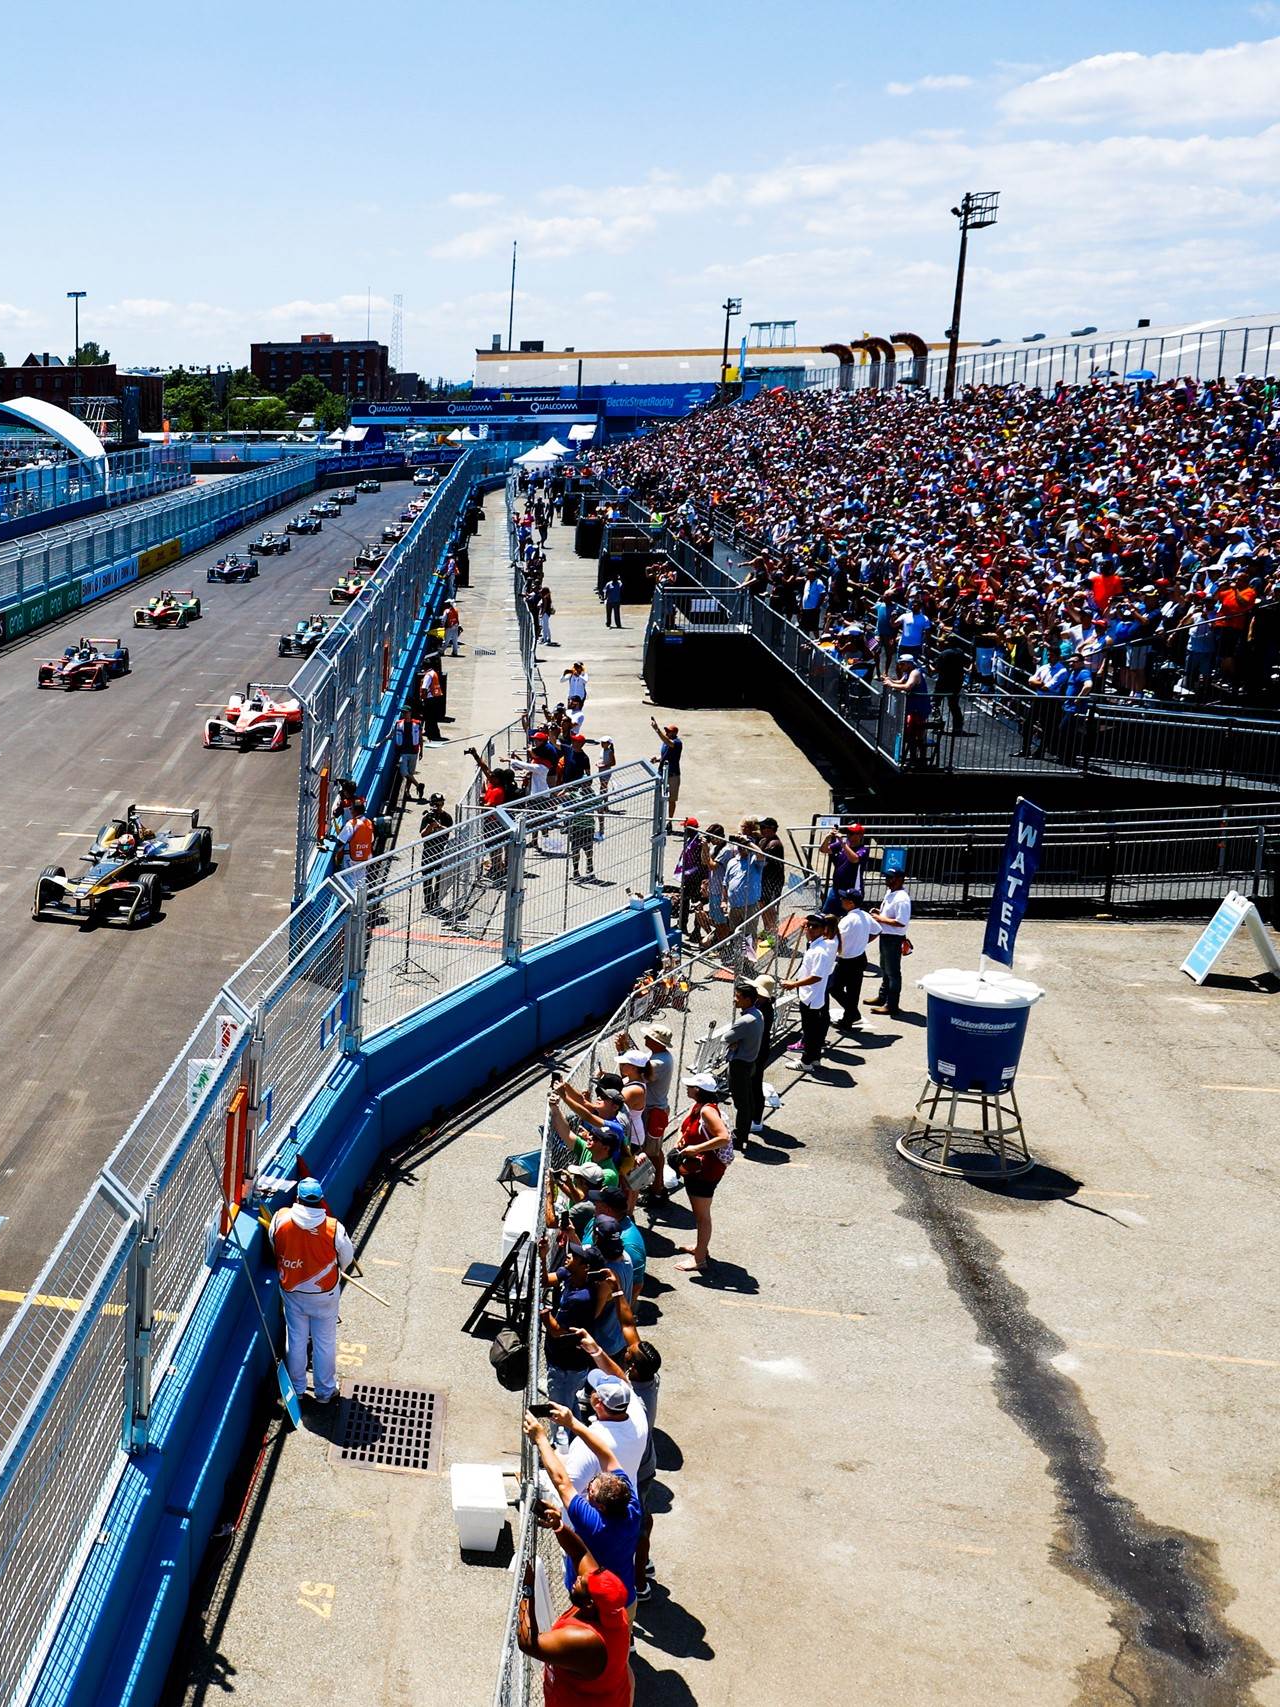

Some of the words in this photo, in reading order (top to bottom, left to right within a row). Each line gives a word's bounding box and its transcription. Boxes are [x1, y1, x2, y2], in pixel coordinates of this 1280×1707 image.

[368, 404, 411, 416] QUALCOMM
[447, 403, 492, 415] QUALCOMM
[530, 402, 577, 414] QUALCOMM
[997, 820, 1038, 952] WATER
[297, 1581, 336, 1619] 57
